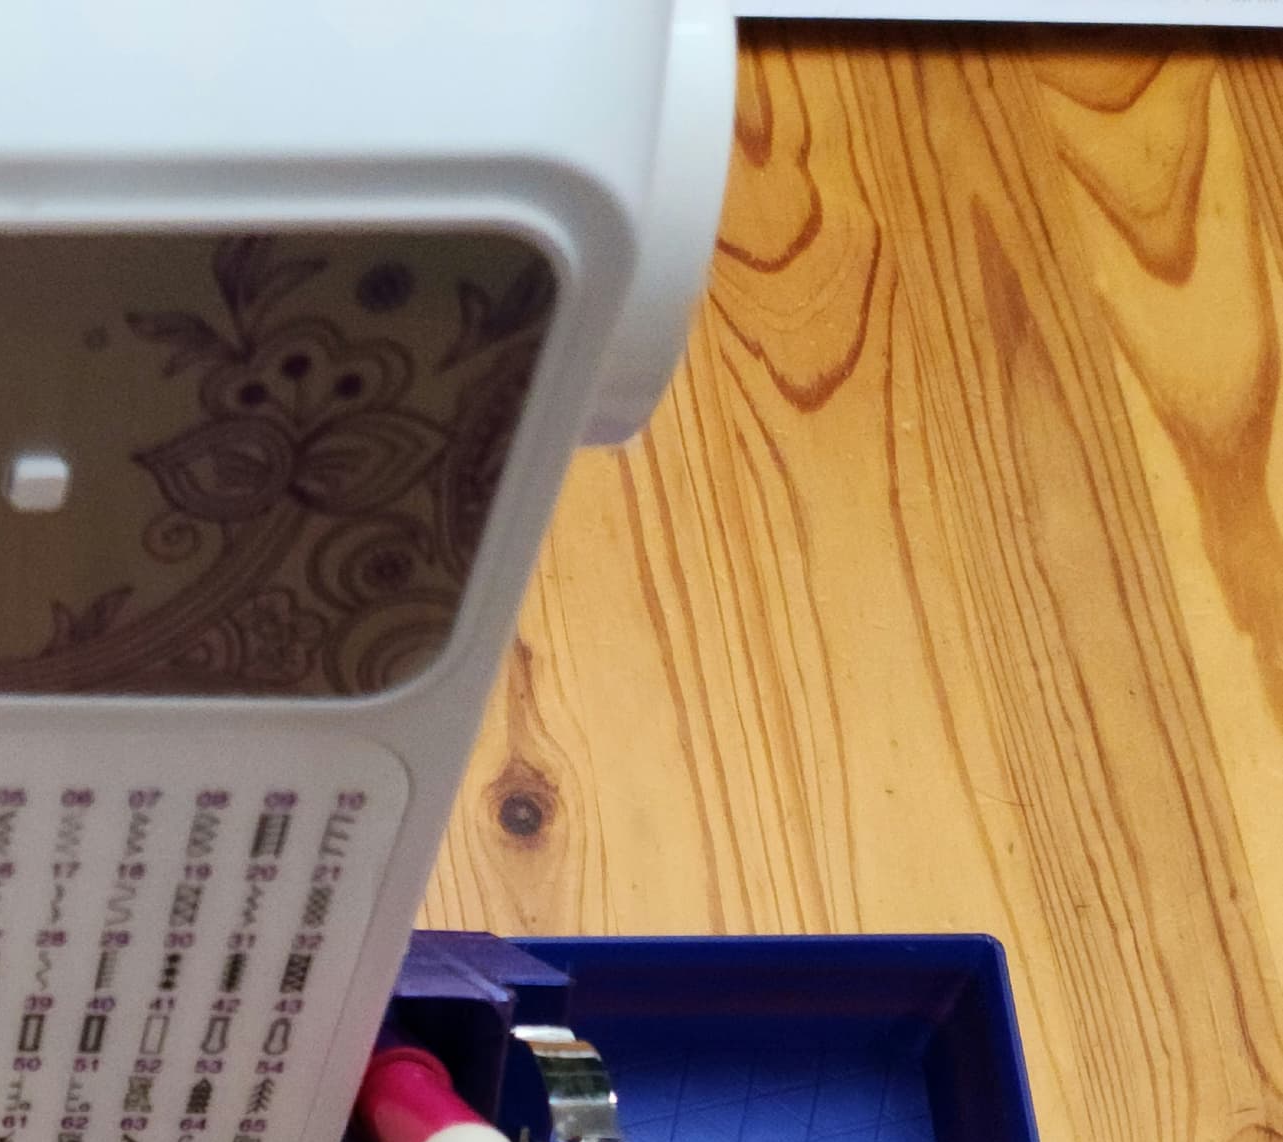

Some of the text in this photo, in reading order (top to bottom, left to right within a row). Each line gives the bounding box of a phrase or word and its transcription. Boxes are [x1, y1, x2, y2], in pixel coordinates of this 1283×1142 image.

[12, 1057, 41, 1072] 50
[73, 1058, 99, 1072] 51
[134, 1058, 163, 1073] 52
[194, 1059, 223, 1074] 53
[255, 1060, 284, 1075] 54
[1, 1115, 28, 1129] 61
[60, 1116, 88, 1130] 62
[120, 1117, 148, 1131] 63
[179, 1118, 207, 1131] 64
[238, 1119, 266, 1132] 65
